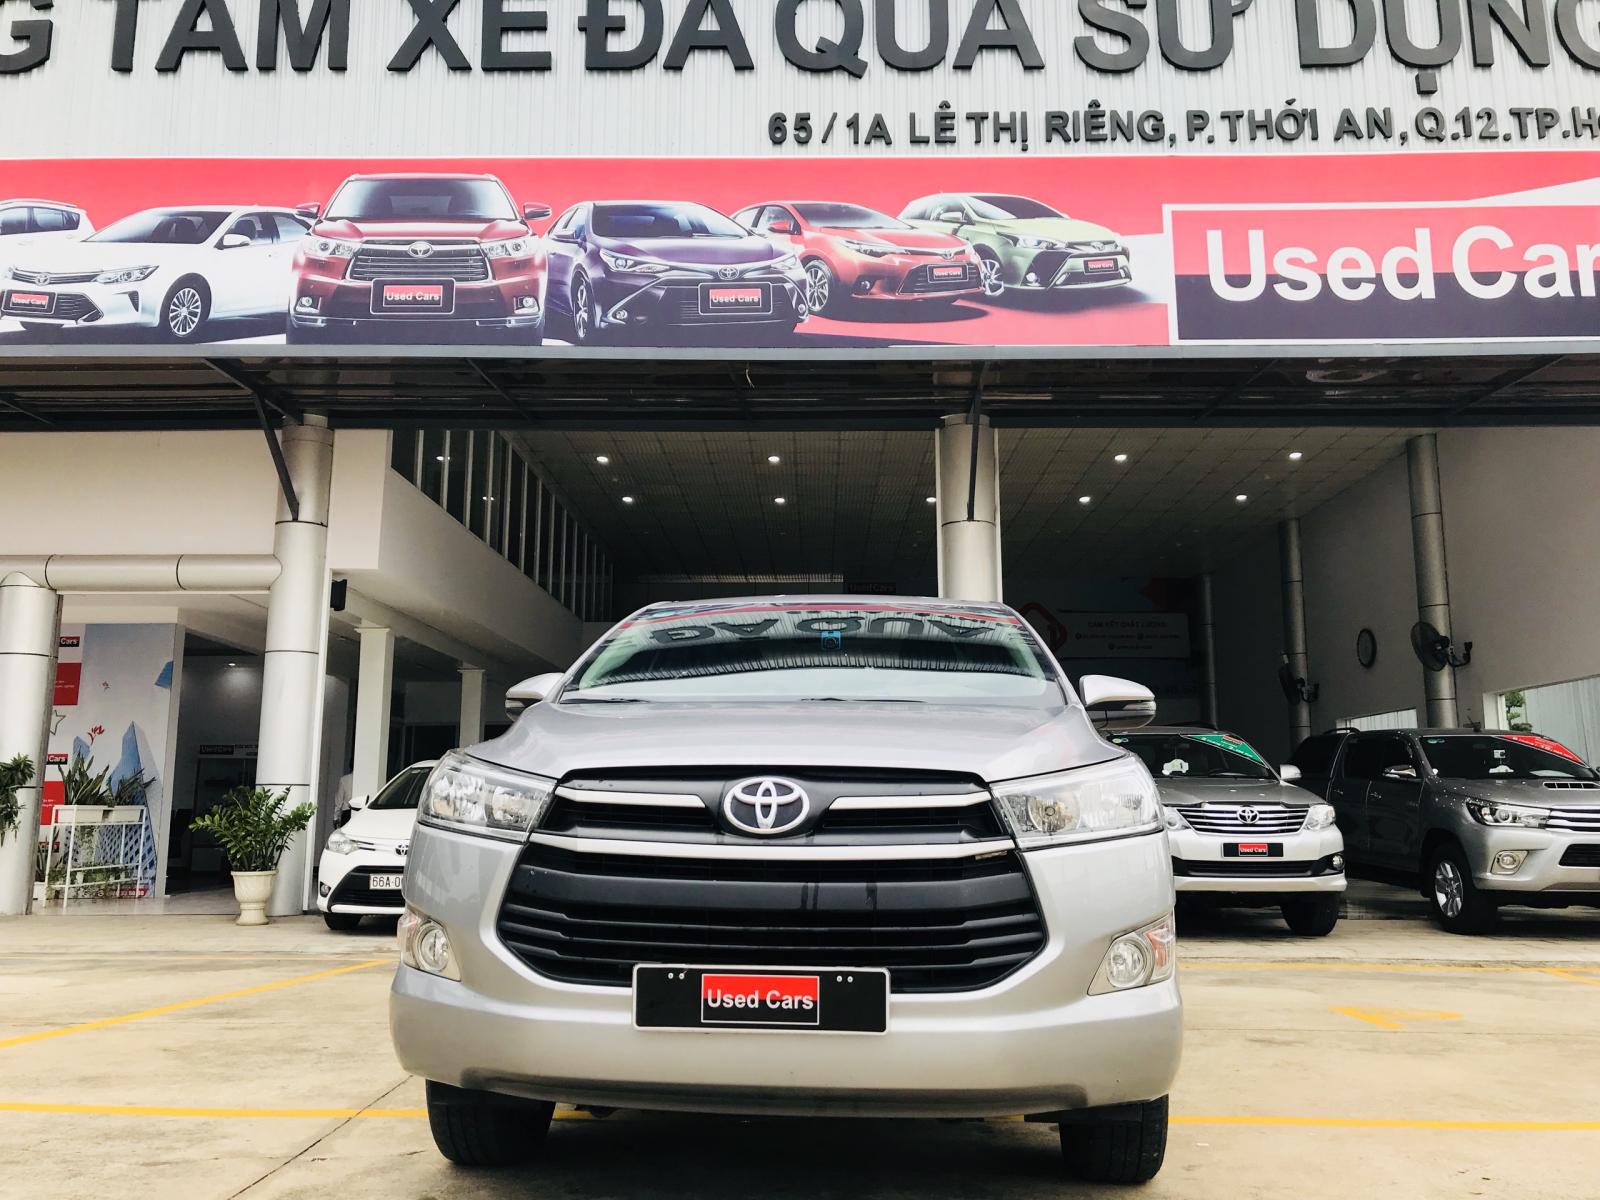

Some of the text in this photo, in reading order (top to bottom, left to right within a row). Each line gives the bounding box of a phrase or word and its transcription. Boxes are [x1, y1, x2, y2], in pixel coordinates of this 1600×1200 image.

[909, 100, 957, 144] LÊ
[966, 111, 1028, 151] THỊ
[1206, 227, 1437, 301] Used
[386, 291, 440, 301] Used Cars
[712, 294, 759, 303] Used Cars
[60, 637, 78, 645] Cars
[707, 988, 814, 1010] Used Cars
